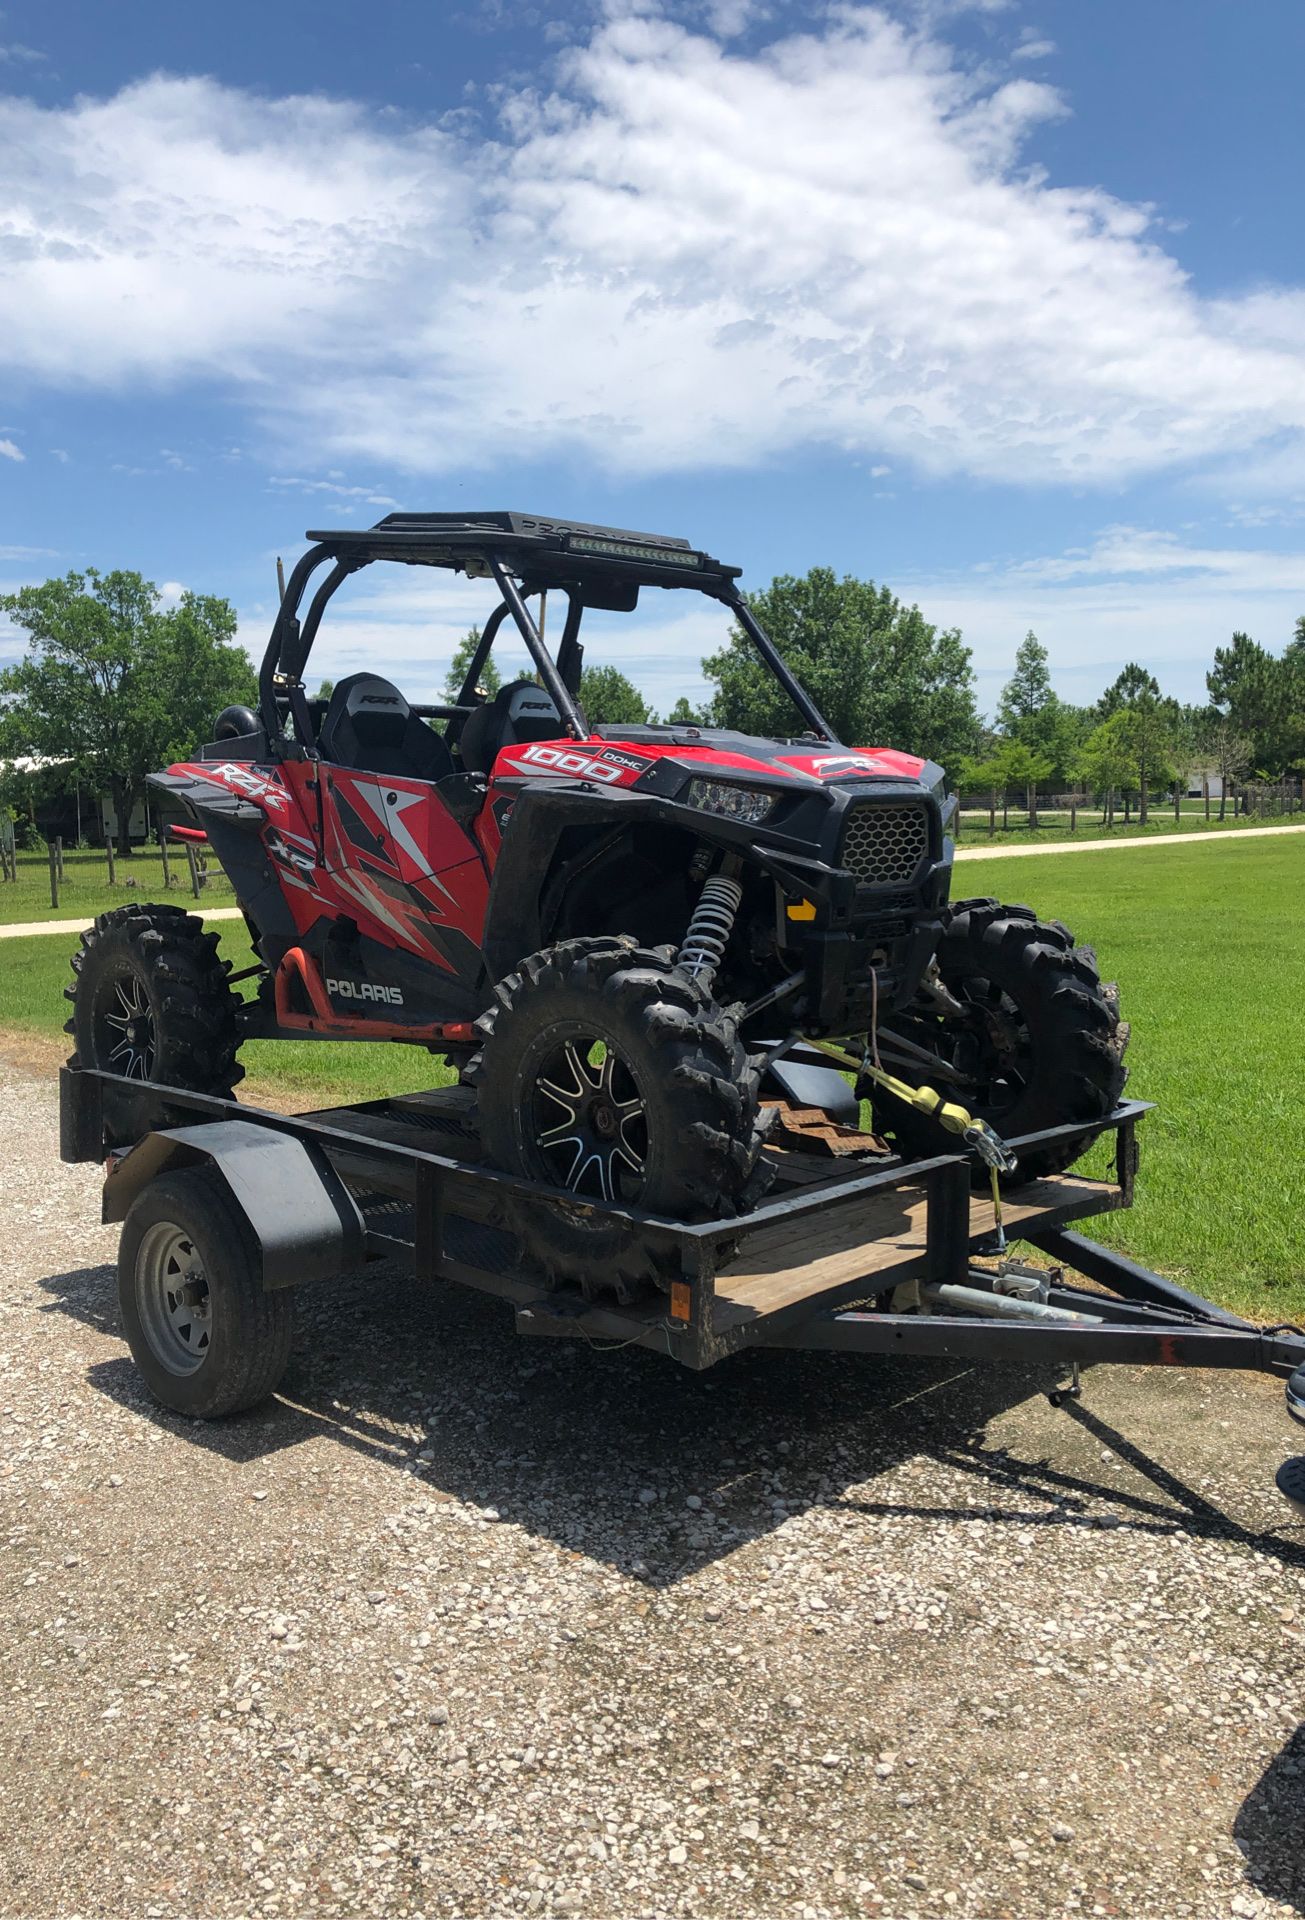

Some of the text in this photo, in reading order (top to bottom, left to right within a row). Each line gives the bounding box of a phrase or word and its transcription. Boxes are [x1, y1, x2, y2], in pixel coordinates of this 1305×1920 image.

[360, 695, 399, 705] RZR
[521, 746, 623, 783] 1000
[602, 752, 644, 770] DOHC
[268, 837, 316, 870] XP
[326, 978, 404, 1005] POLARIS
